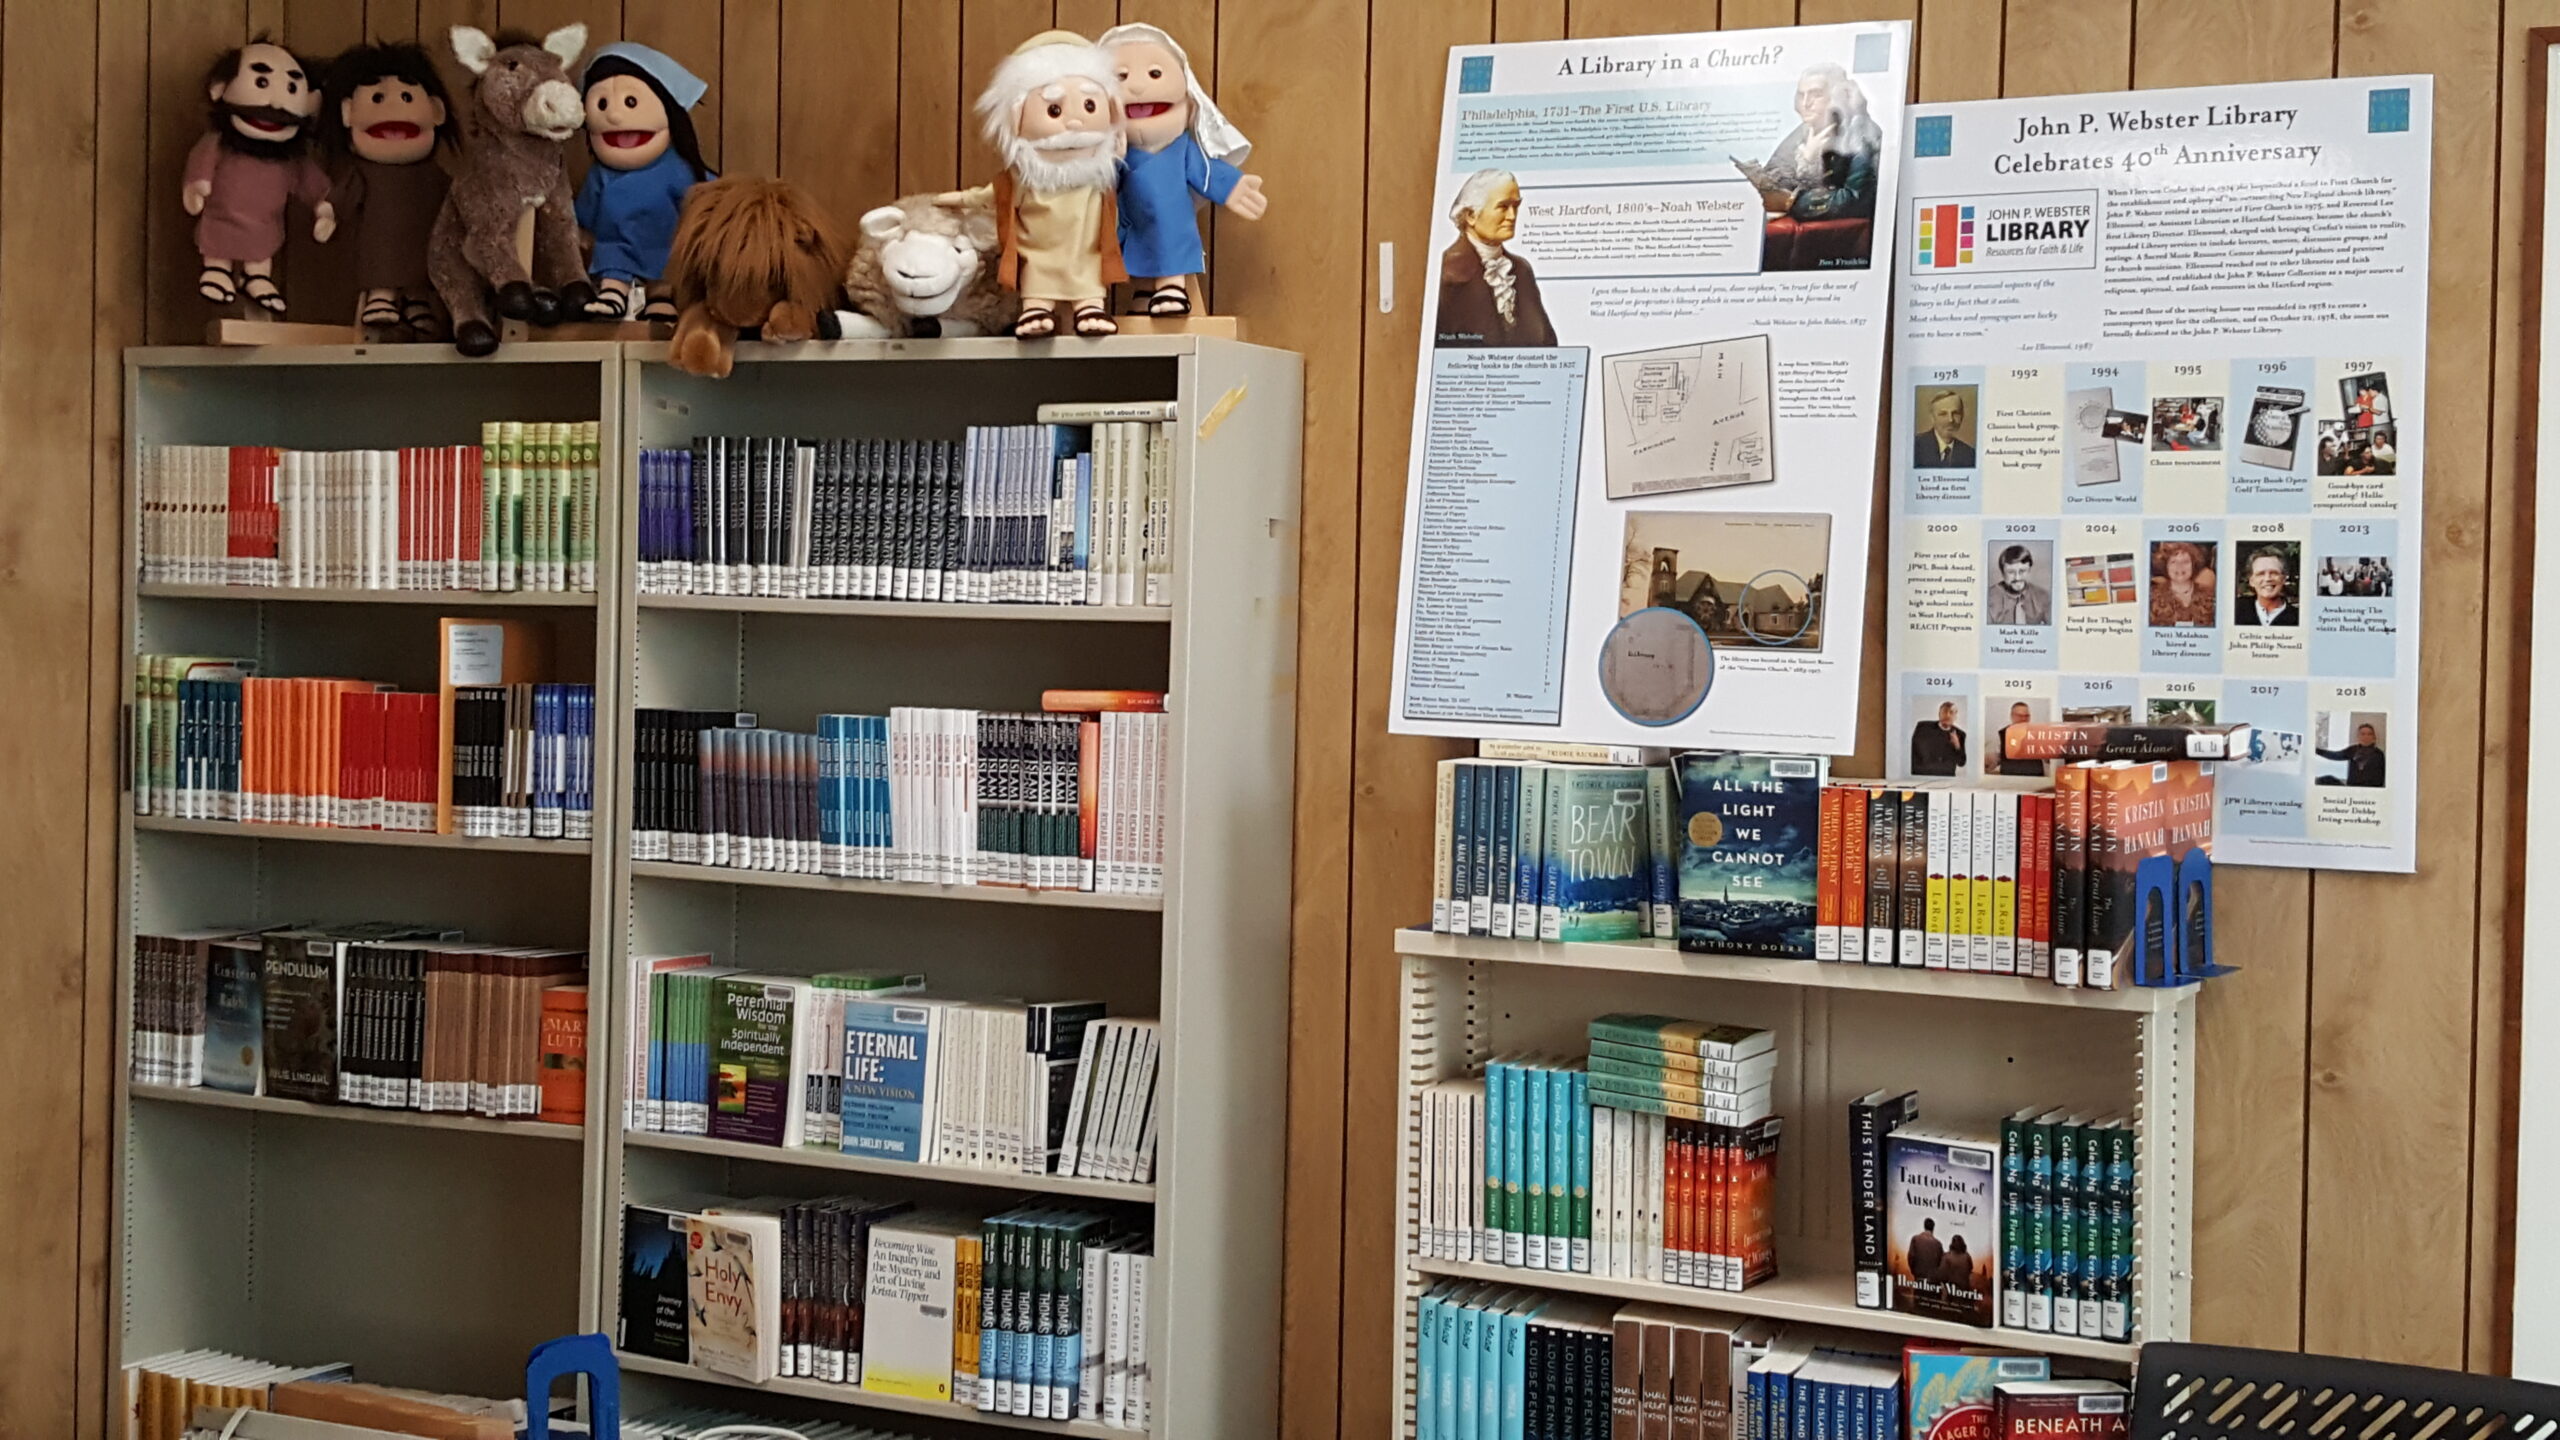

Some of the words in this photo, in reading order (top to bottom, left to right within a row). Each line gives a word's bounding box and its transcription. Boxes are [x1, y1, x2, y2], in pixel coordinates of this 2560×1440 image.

[1557, 58, 1573, 75] A
[1580, 56, 1655, 78] Library
[1661, 53, 1682, 70] in
[1690, 56, 1699, 69] a
[1707, 45, 1784, 67] Church?
[1462, 107, 1537, 121] Philadelphia,
[1605, 104, 1635, 114] First
[1638, 102, 1660, 113] U.S.
[1666, 100, 1711, 114] Library
[2014, 117, 2070, 143] John
[2079, 114, 2099, 134] P.
[2108, 111, 2199, 131] Webster
[2207, 105, 2298, 129] Library
[1994, 154, 2114, 174] Celebrates
[2121, 145, 2168, 172] 40th
[2174, 143, 2322, 166] Anniversary
[1528, 205, 1554, 217] West
[1558, 203, 1611, 217] Hartford,
[1697, 201, 1744, 212] Webster
[1987, 210, 2020, 220] JOHN
[2024, 208, 2032, 217] P.
[2039, 206, 2090, 217] WEBSTER
[1986, 220, 2089, 242] LIBRARY
[1986, 246, 2023, 256] Resources
[2026, 245, 2037, 255] for
[2039, 244, 2058, 254] Faith
[2060, 244, 2067, 253] &
[2069, 243, 2083, 254] Life
[2012, 369, 2038, 378] 1992
[2091, 367, 2119, 377] 1994
[2175, 365, 2201, 375] 1995
[2258, 362, 2287, 372] 1996
[2345, 362, 2373, 371] 1997
[1933, 370, 1958, 380] 1978
[1927, 524, 1958, 532] 2000
[2085, 525, 2117, 534] 2004
[2168, 523, 2200, 533] 2006
[2252, 523, 2284, 533] 2008
[2339, 525, 2369, 534] 2013
[1926, 677, 1953, 687] 2014
[2004, 680, 2032, 690] 2015
[2084, 680, 2112, 690] 2016
[2166, 682, 2195, 692] 2016
[2250, 686, 2279, 695] 2017
[2336, 687, 2366, 697] 2018
[2027, 731, 2088, 741] KRISTIN
[2027, 745, 2088, 755] HANNAH
[2106, 743, 2137, 753] Great
[2142, 743, 2173, 753] Alone
[999, 759, 1008, 797] ISLAM
[1043, 761, 1051, 800] ISLAM
[1712, 779, 1743, 792] ALL
[1750, 781, 1784, 793] THE
[1723, 805, 1775, 817] LIGHT
[1884, 809, 1893, 823] MY
[2125, 799, 2165, 824] KRISTIN
[1571, 805, 1636, 844] BEAR
[2056, 790, 2065, 852] HANNAH
[2071, 790, 2080, 852] KRISTIN
[1736, 828, 1761, 840] WE
[1874, 804, 1883, 859] HAMILTON
[1884, 826, 1892, 856] DEAR
[2124, 828, 2164, 854] HANNAH
[1568, 846, 1635, 882] TOWN
[1711, 851, 1785, 865] CANNOT
[1732, 875, 1762, 887] SEE
[1690, 939, 1753, 950] ANTHONY
[1761, 943, 1804, 952] DOERR
[266, 960, 329, 979] PENDULUM
[728, 993, 787, 1011] Perennial
[737, 1008, 786, 1024] Wisdom
[732, 1028, 780, 1043] Spiritually
[721, 1039, 784, 1055] Independent
[847, 1030, 918, 1060] ETERNAL
[845, 1057, 884, 1083] LIFE:
[292, 1072, 329, 1085] LINDAHL
[854, 1086, 876, 1096] NEW
[879, 1088, 915, 1099] VISION
[1861, 1111, 1872, 1146] THIS
[2008, 1131, 2017, 1170] Celeste
[1933, 1165, 1946, 1173] The
[1861, 1151, 1874, 1209] TENDER
[1899, 1166, 1967, 1193] Tattooist
[1971, 1182, 1985, 1195] of
[2008, 1174, 2017, 1185] Ng
[1905, 1190, 1978, 1216] Auschwitz
[2008, 1193, 2017, 1214] Little
[1863, 1215, 1874, 1255] LAND
[2009, 1215, 2018, 1239] Fires
[874, 1238, 914, 1252] Becoming
[917, 1244, 935, 1255] Wise
[874, 1251, 886, 1260] An
[888, 1252, 918, 1267] Inquiry
[921, 1256, 937, 1267] into
[706, 1257, 742, 1292] Holy
[874, 1263, 886, 1272] the
[889, 1265, 922, 1279] Mystery
[924, 1270, 940, 1280] and
[873, 1276, 885, 1285] Art
[888, 1278, 898, 1286] of
[900, 1279, 925, 1289] Living
[1897, 1275, 1943, 1294] Heather
[1945, 1283, 1983, 1300] Morris
[706, 1282, 742, 1316] Envy
[871, 1288, 897, 1298] Krista
[900, 1290, 929, 1303] Tippett
[982, 1288, 994, 1328] THOMAS
[656, 1319, 682, 1330] Universe
[981, 1330, 992, 1364] BERRY
[1529, 1341, 1538, 1388] LOUISE
[1529, 1392, 1537, 1436] PENNY
[1971, 1414, 1988, 1424] THE
[2015, 1418, 2105, 1435] BENEATH
[2112, 1419, 2125, 1433] A
